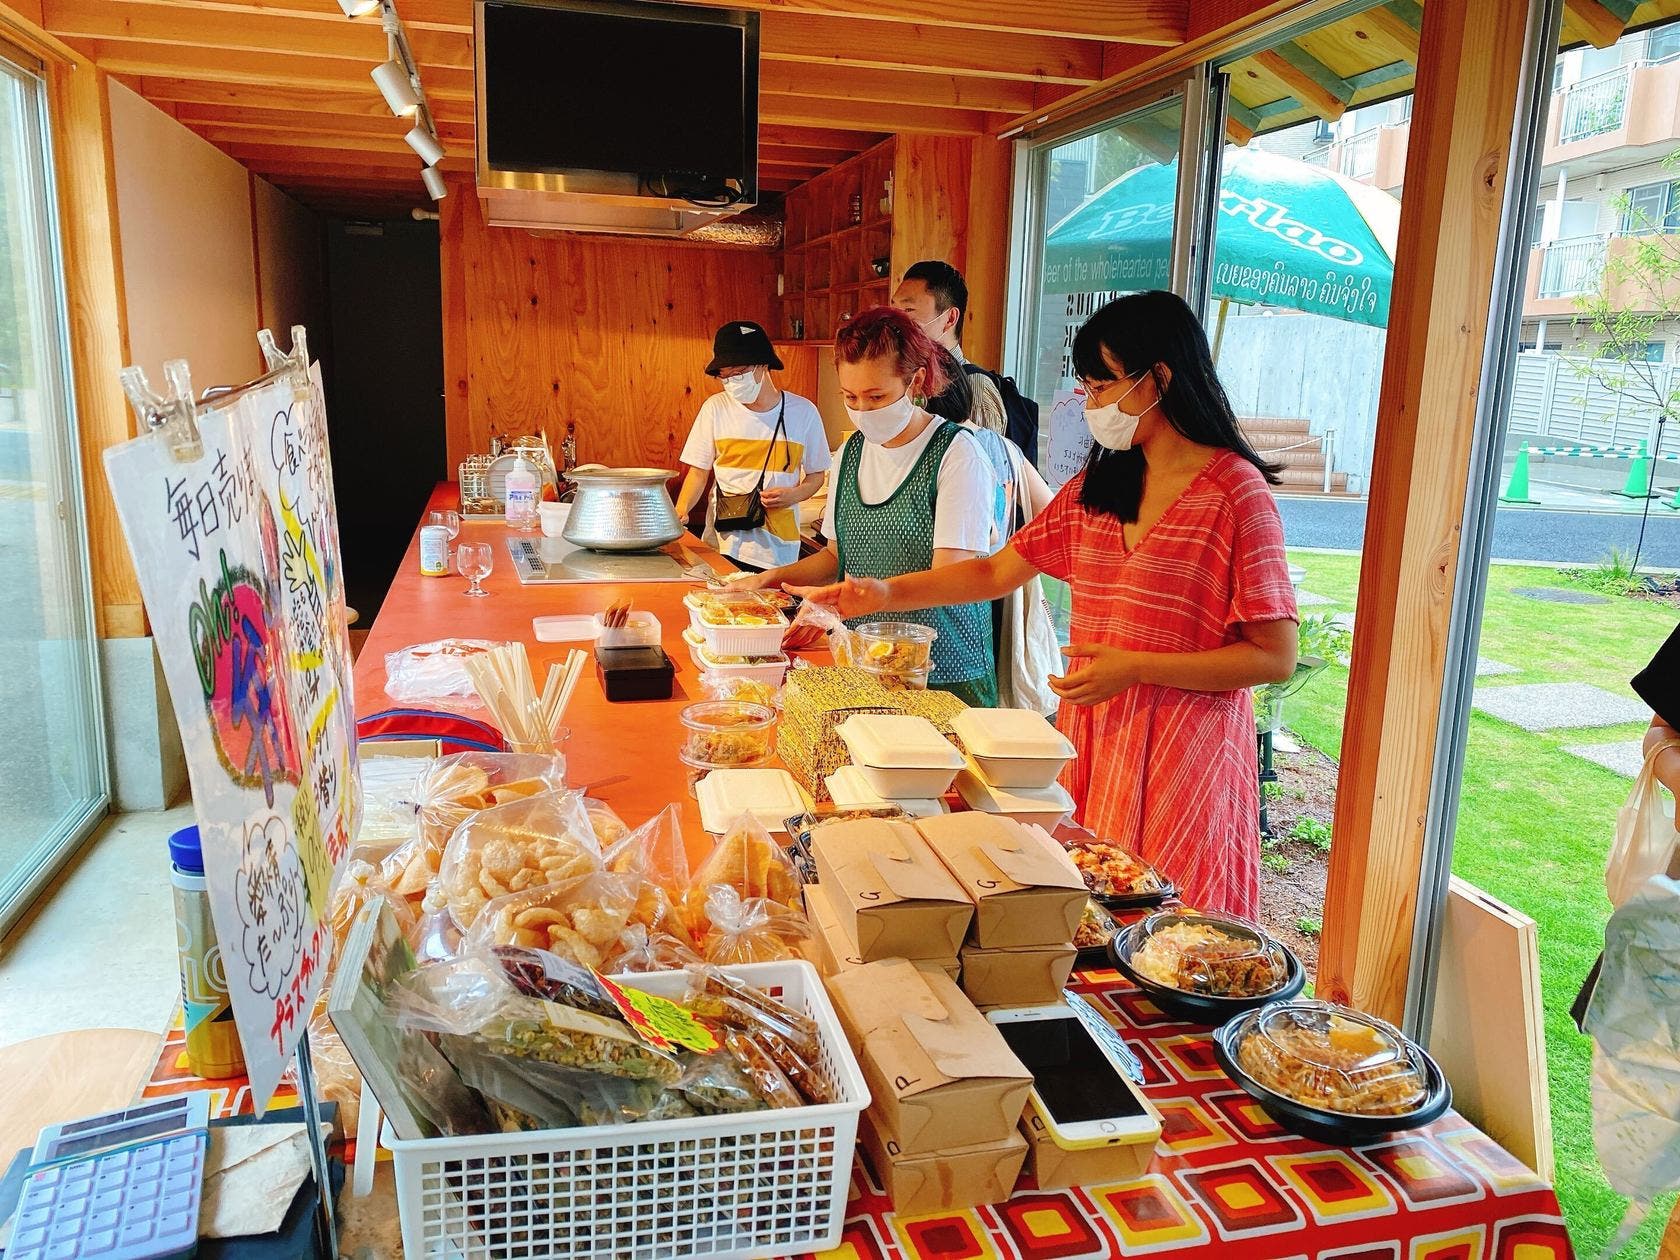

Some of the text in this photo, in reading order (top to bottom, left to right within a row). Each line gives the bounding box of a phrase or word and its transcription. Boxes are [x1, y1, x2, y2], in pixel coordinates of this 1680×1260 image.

[1063, 257, 1073, 282] of
[1074, 256, 1088, 281] the
[1091, 252, 1154, 281] wholehearted
